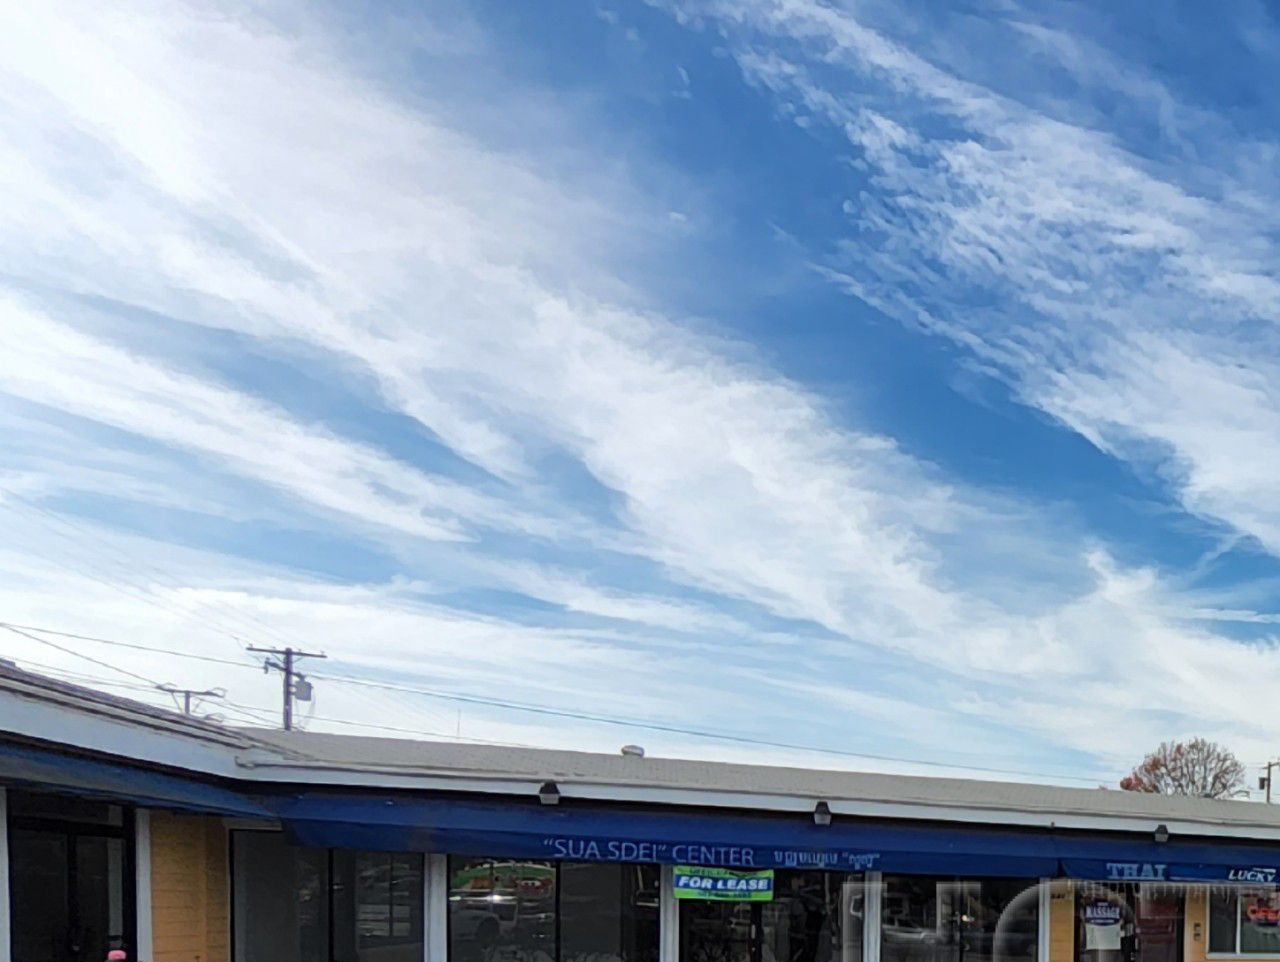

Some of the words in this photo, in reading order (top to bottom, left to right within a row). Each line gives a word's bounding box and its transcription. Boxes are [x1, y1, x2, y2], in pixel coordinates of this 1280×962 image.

[672, 845, 754, 866] CENTER
[1106, 863, 1167, 880] THAI
[1228, 868, 1276, 882] LUCKY
[678, 876, 712, 889] FOR
[717, 878, 768, 890] LEASE
